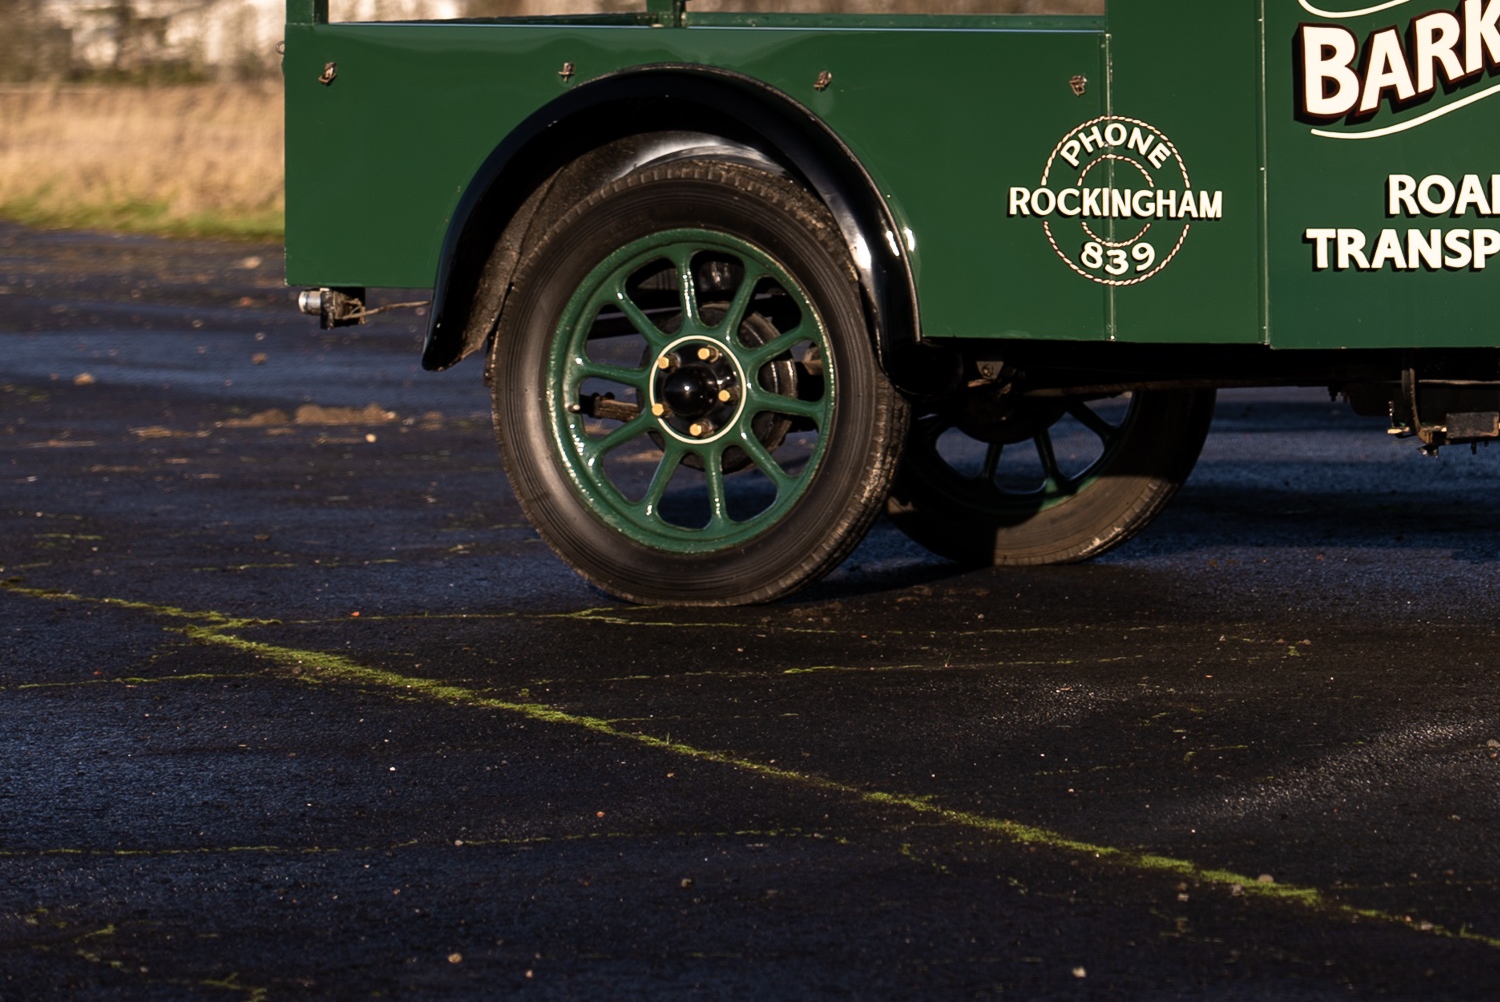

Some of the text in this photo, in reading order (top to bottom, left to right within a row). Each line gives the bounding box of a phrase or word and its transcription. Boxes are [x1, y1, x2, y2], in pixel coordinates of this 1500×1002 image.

[1059, 122, 1172, 170] PHONE
[1008, 186, 1223, 219] ROCKINGHAM
[1080, 241, 1156, 276] 839
